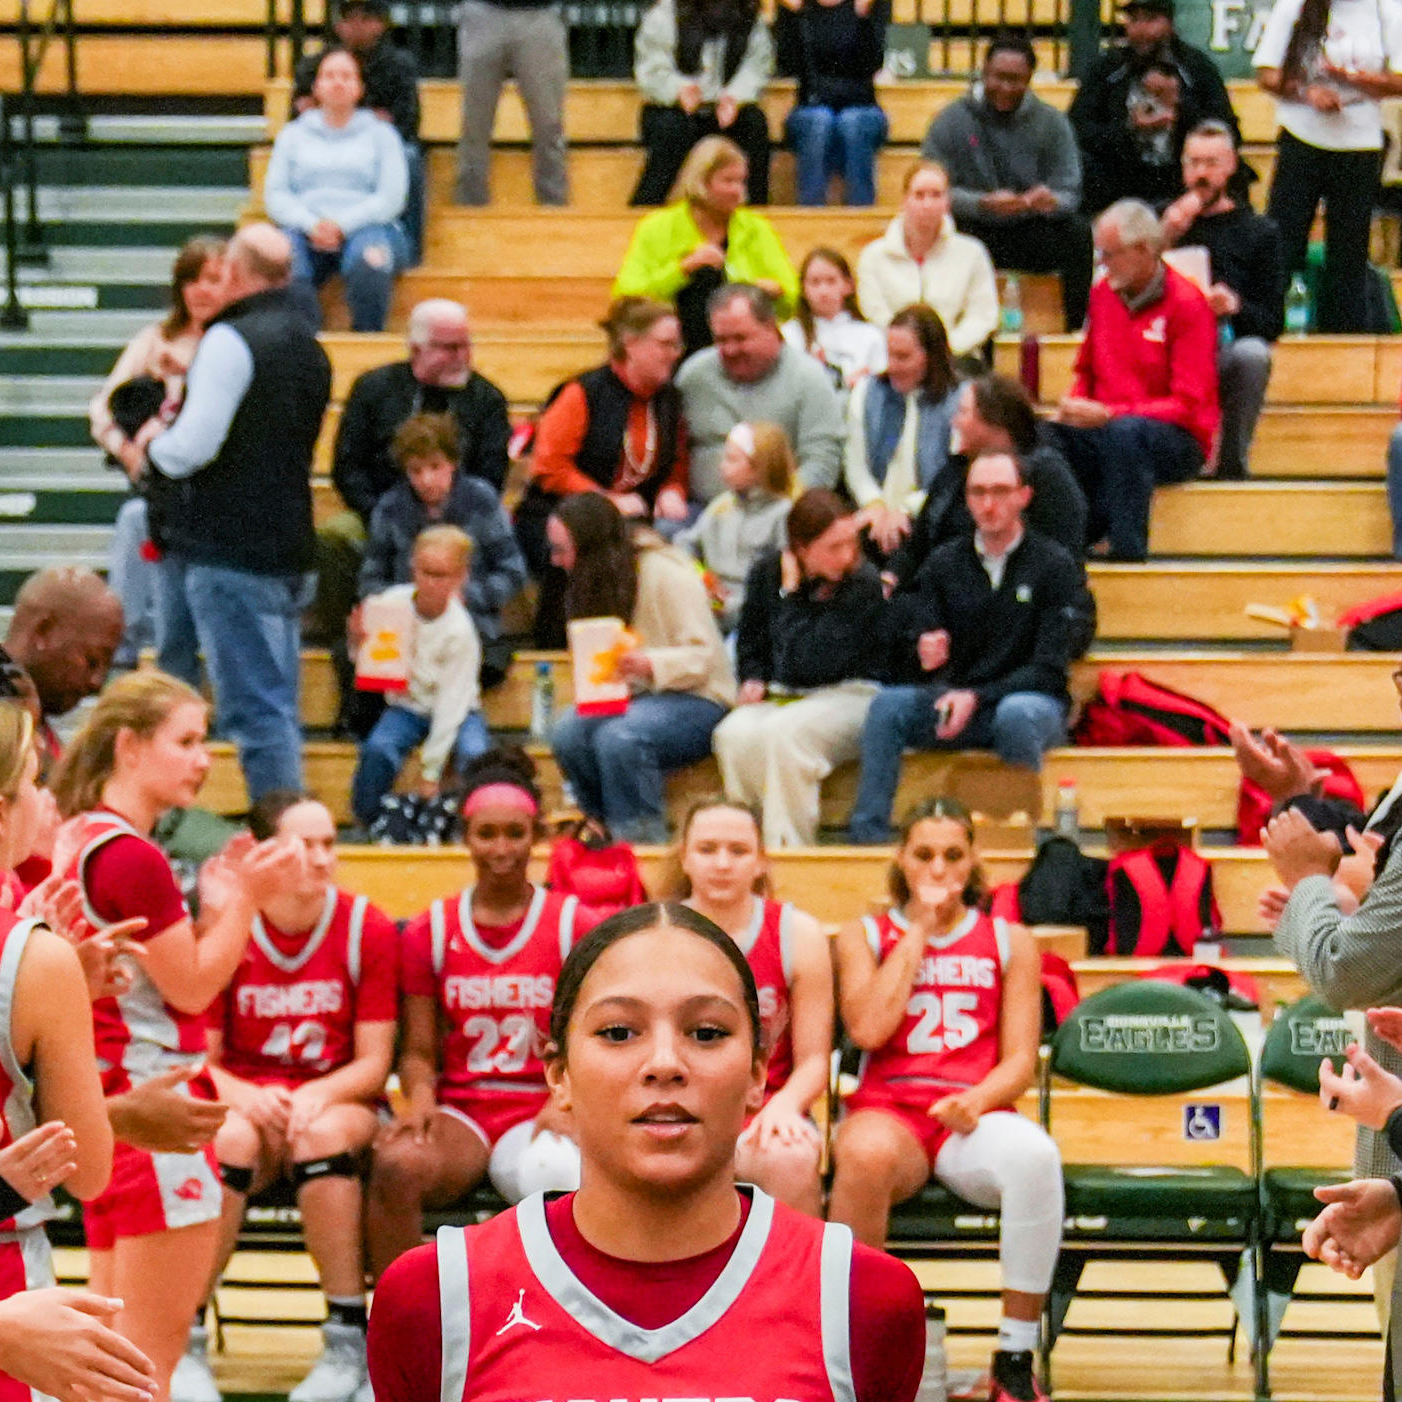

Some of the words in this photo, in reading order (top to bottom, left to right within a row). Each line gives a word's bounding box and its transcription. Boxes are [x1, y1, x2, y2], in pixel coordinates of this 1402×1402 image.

[237, 978, 344, 1019] FISHERS
[445, 974, 554, 1010] FISHERS
[905, 991, 980, 1055] 25
[1078, 1014, 1220, 1053] EAGLES
